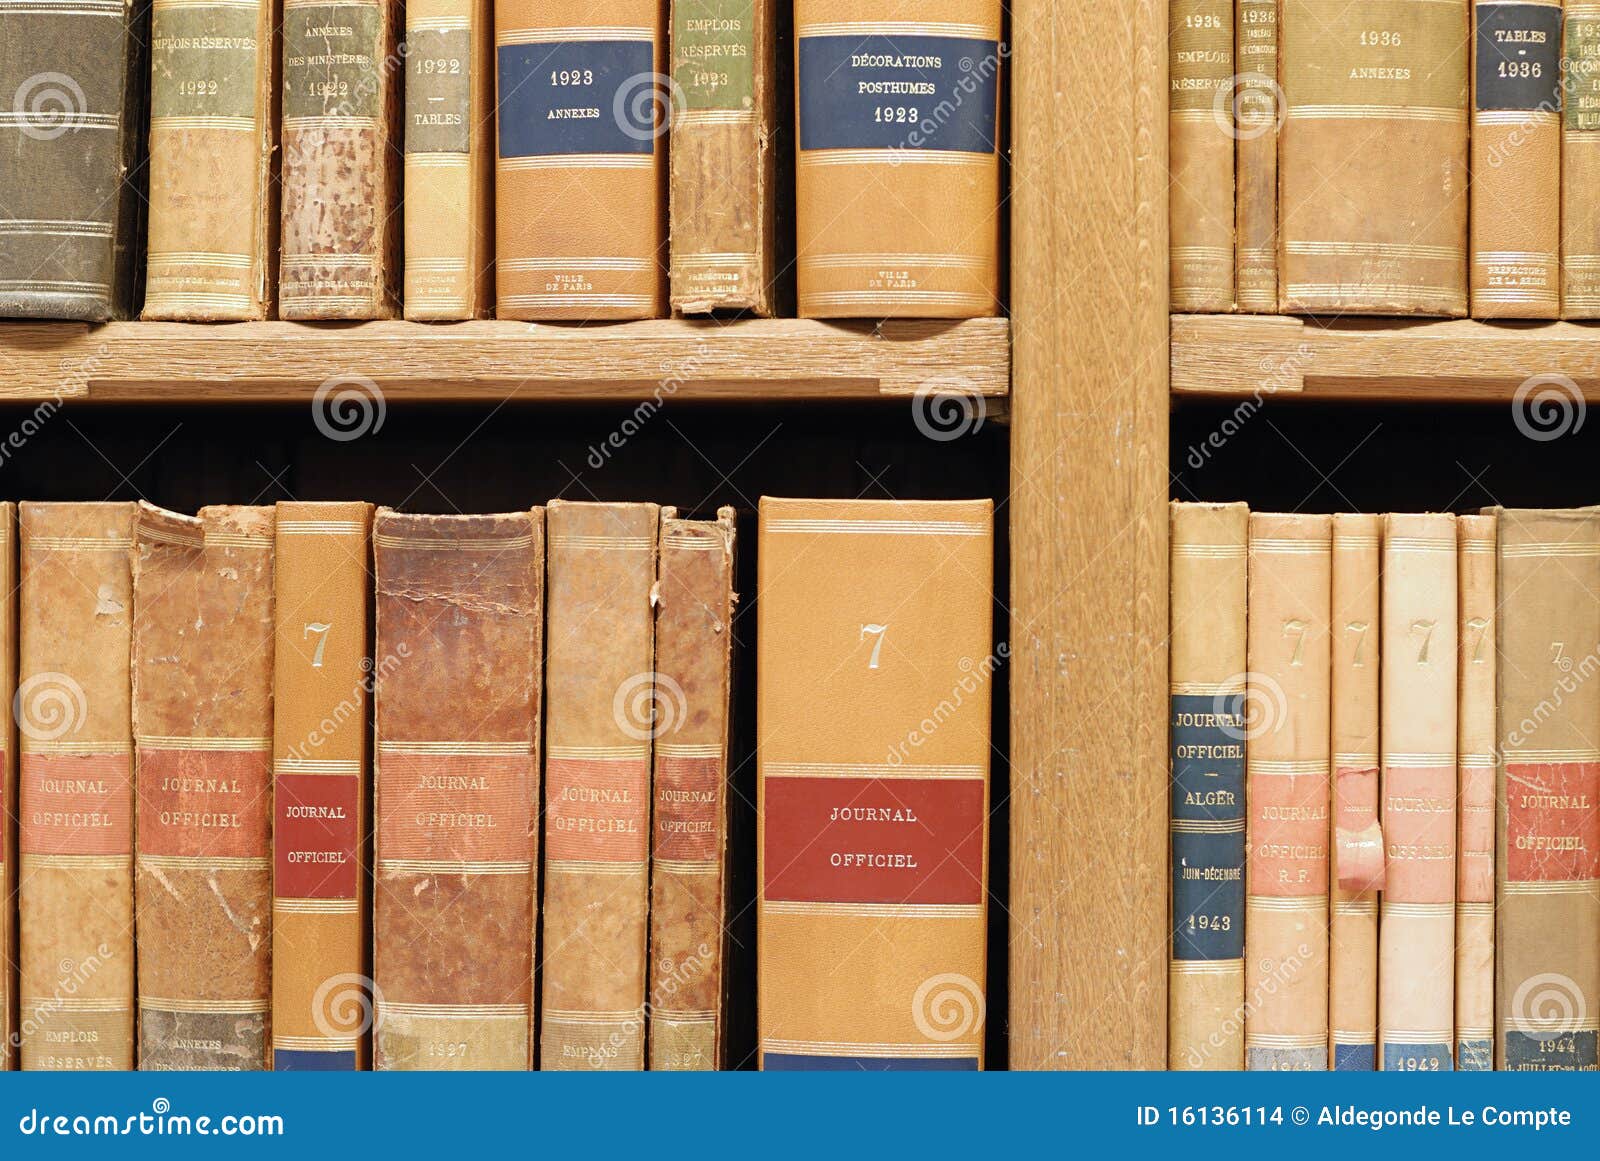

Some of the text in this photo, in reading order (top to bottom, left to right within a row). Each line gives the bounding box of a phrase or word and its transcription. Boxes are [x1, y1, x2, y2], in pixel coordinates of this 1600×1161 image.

[1185, 15, 1222, 28] 1936
[1242, 10, 1276, 23] 1936
[304, 26, 353, 37] ANNEXES
[687, 19, 741, 31] EMPLOIS
[192, 36, 256, 49] RÉSERVÉS
[1360, 31, 1402, 46] 1936
[1494, 30, 1547, 43] TABLES
[680, 43, 747, 57] RÉSERVÉS
[288, 57, 305, 67] DES
[416, 58, 460, 74] 1922
[851, 53, 942, 69] DÉCORATIONS
[1348, 67, 1412, 80] ANNEXES
[1498, 62, 1542, 78] 1936
[551, 70, 593, 86] 1923
[693, 72, 728, 87] 1923
[179, 81, 217, 95] 1922
[309, 82, 348, 97] 1922
[858, 82, 936, 95] POSTHUMES
[414, 113, 462, 125] TABLES
[547, 108, 600, 119] ANNEXES
[874, 107, 919, 123] 1923
[554, 274, 585, 283] VILLE
[878, 271, 909, 280] VILLE
[545, 282, 593, 291] DE PARIS
[869, 279, 917, 288] DE PARIS
[304, 622, 333, 667] 7
[860, 623, 888, 669] 7
[1282, 619, 1308, 667] 7
[1344, 620, 1370, 668] 7
[1410, 619, 1438, 667] 7
[1466, 617, 1491, 664] 7
[1550, 642, 1564, 664] 7
[1176, 713, 1243, 727] JOURNAL
[1177, 745, 1243, 759] OFFICIEL
[39, 780, 107, 793] JOURNAL
[162, 778, 241, 793] JOURNAL
[419, 775, 490, 790] JOURNAL
[561, 787, 632, 803] JOURNAL
[660, 790, 715, 802] JOURNAL
[1184, 791, 1235, 806] ALGER
[1520, 795, 1590, 809] JOURNAL
[32, 812, 113, 826] OFFICIEL
[160, 811, 241, 828] OFFICIEL
[286, 806, 346, 819] JOURNAL
[830, 807, 918, 822] JOURNAL
[1262, 806, 1327, 820] JOURNAL
[415, 813, 497, 827] OFFICIEL
[556, 817, 637, 832] OFFICIEL
[660, 821, 715, 833] OFFICIEL
[1516, 836, 1586, 850] OFFICIEL
[288, 851, 346, 864] OFFICIEL
[1259, 844, 1326, 859] OFFICIEL
[830, 853, 918, 868] OFFICIEL
[1188, 914, 1231, 931] 1943
[46, 1031, 99, 1043] EMPLOIS
[174, 1039, 222, 1050] ANNEXES
[429, 1042, 468, 1057] 1927
[563, 1045, 618, 1058] EMPLOIS
[1539, 1040, 1576, 1053] 1944
[1398, 1057, 1440, 1071] 1942
